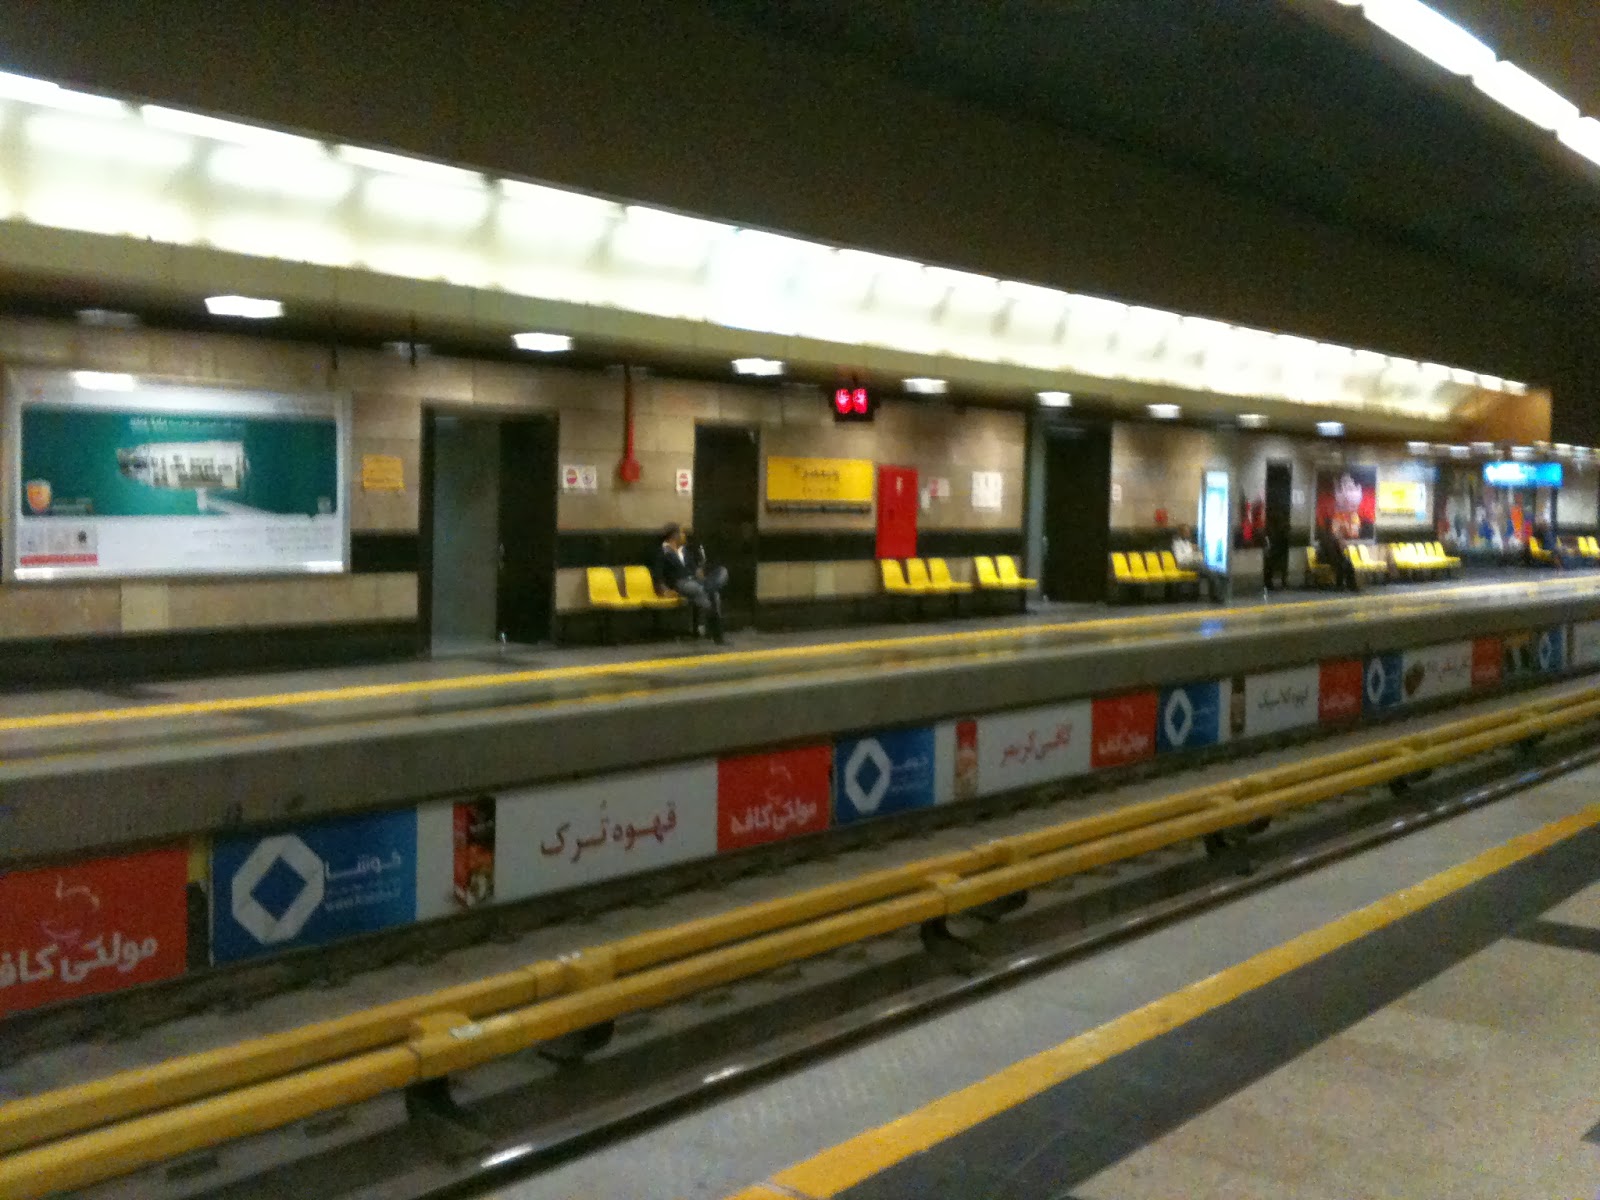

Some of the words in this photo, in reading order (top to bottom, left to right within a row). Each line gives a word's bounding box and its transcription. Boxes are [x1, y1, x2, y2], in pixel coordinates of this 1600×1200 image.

[611, 799, 677, 851] قهوه
[730, 803, 773, 835] کافه
[772, 797, 818, 832] مولتی
[0, 943, 58, 989] کاف
[58, 931, 159, 984] مولتی
